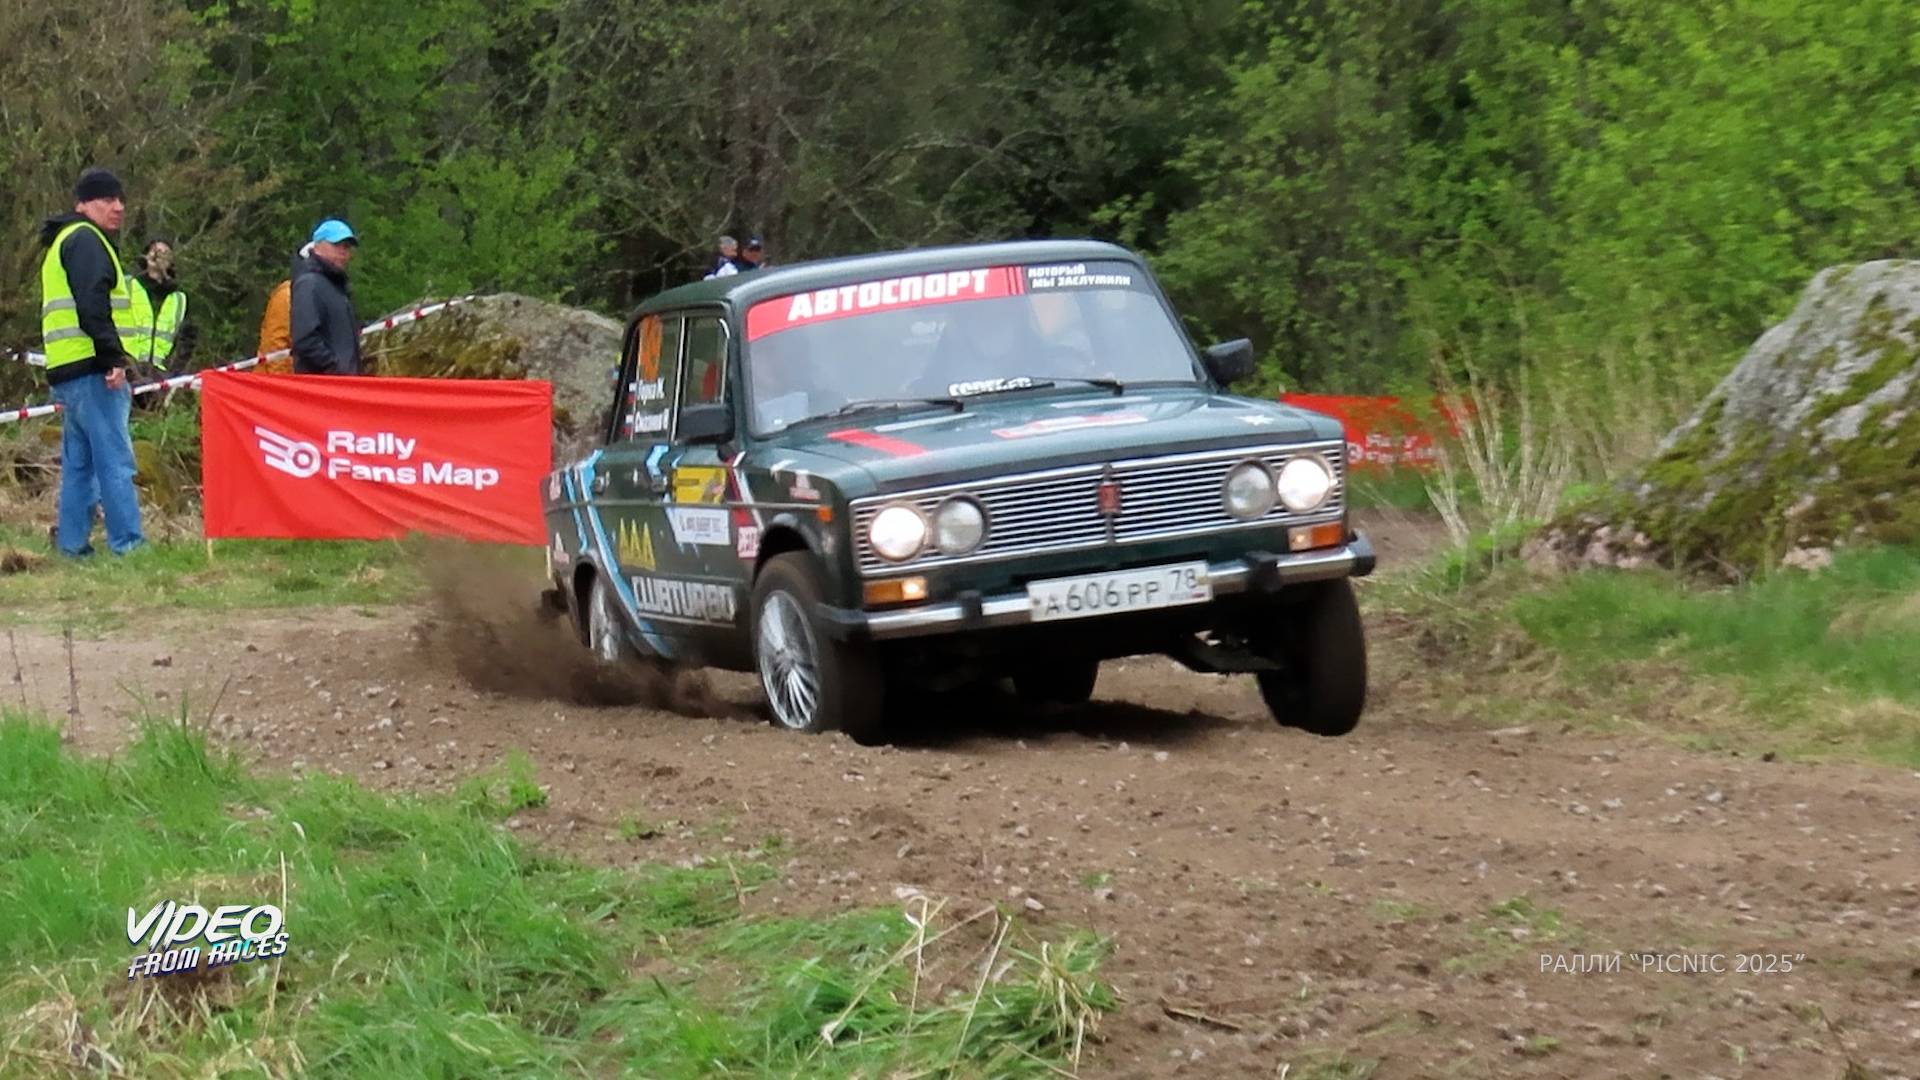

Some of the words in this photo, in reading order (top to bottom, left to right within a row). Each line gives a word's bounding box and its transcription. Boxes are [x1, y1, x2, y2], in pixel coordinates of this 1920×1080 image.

[787, 268, 989, 321] АВТОСПОРТ
[326, 430, 416, 460] Rally
[327, 458, 417, 485] Fans
[422, 462, 500, 491] Map
[1168, 568, 1198, 592] 78
